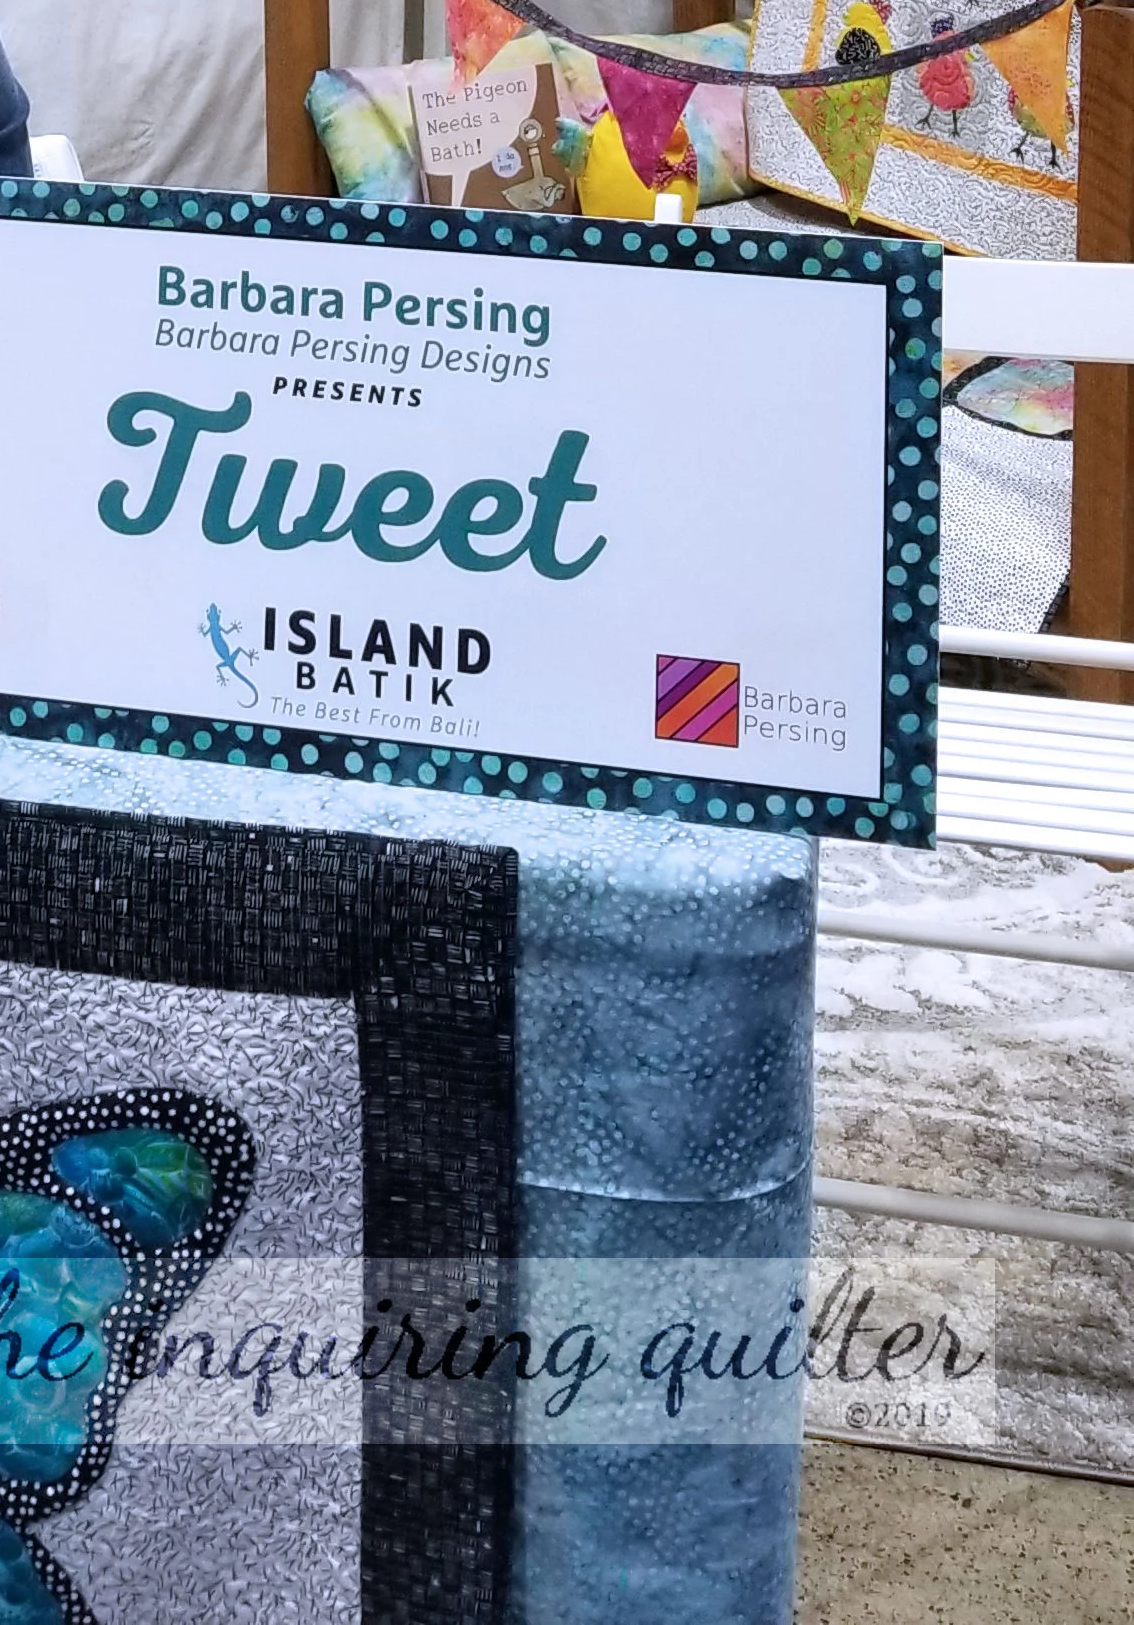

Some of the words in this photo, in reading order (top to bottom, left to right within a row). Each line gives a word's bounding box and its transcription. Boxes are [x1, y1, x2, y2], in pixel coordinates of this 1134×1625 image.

[422, 91, 456, 109] The
[464, 79, 528, 103] Pigeon
[426, 112, 483, 136] Needs
[490, 112, 500, 124] a
[431, 138, 482, 162] Bath!
[157, 264, 344, 320] Barbara
[364, 281, 551, 348] Persing
[155, 318, 280, 355] Barbara
[290, 328, 410, 375] Persing
[420, 340, 551, 383] Designs
[272, 376, 423, 408] PRESENTS
[97, 390, 607, 582] Tweet
[264, 607, 491, 675] ISLAND
[296, 661, 454, 707] BATIK
[744, 685, 846, 719] Barbara
[271, 696, 306, 717] The
[315, 701, 361, 724] Best
[369, 708, 421, 731] From
[430, 715, 480, 738] Bali!
[744, 714, 846, 751] Persing
